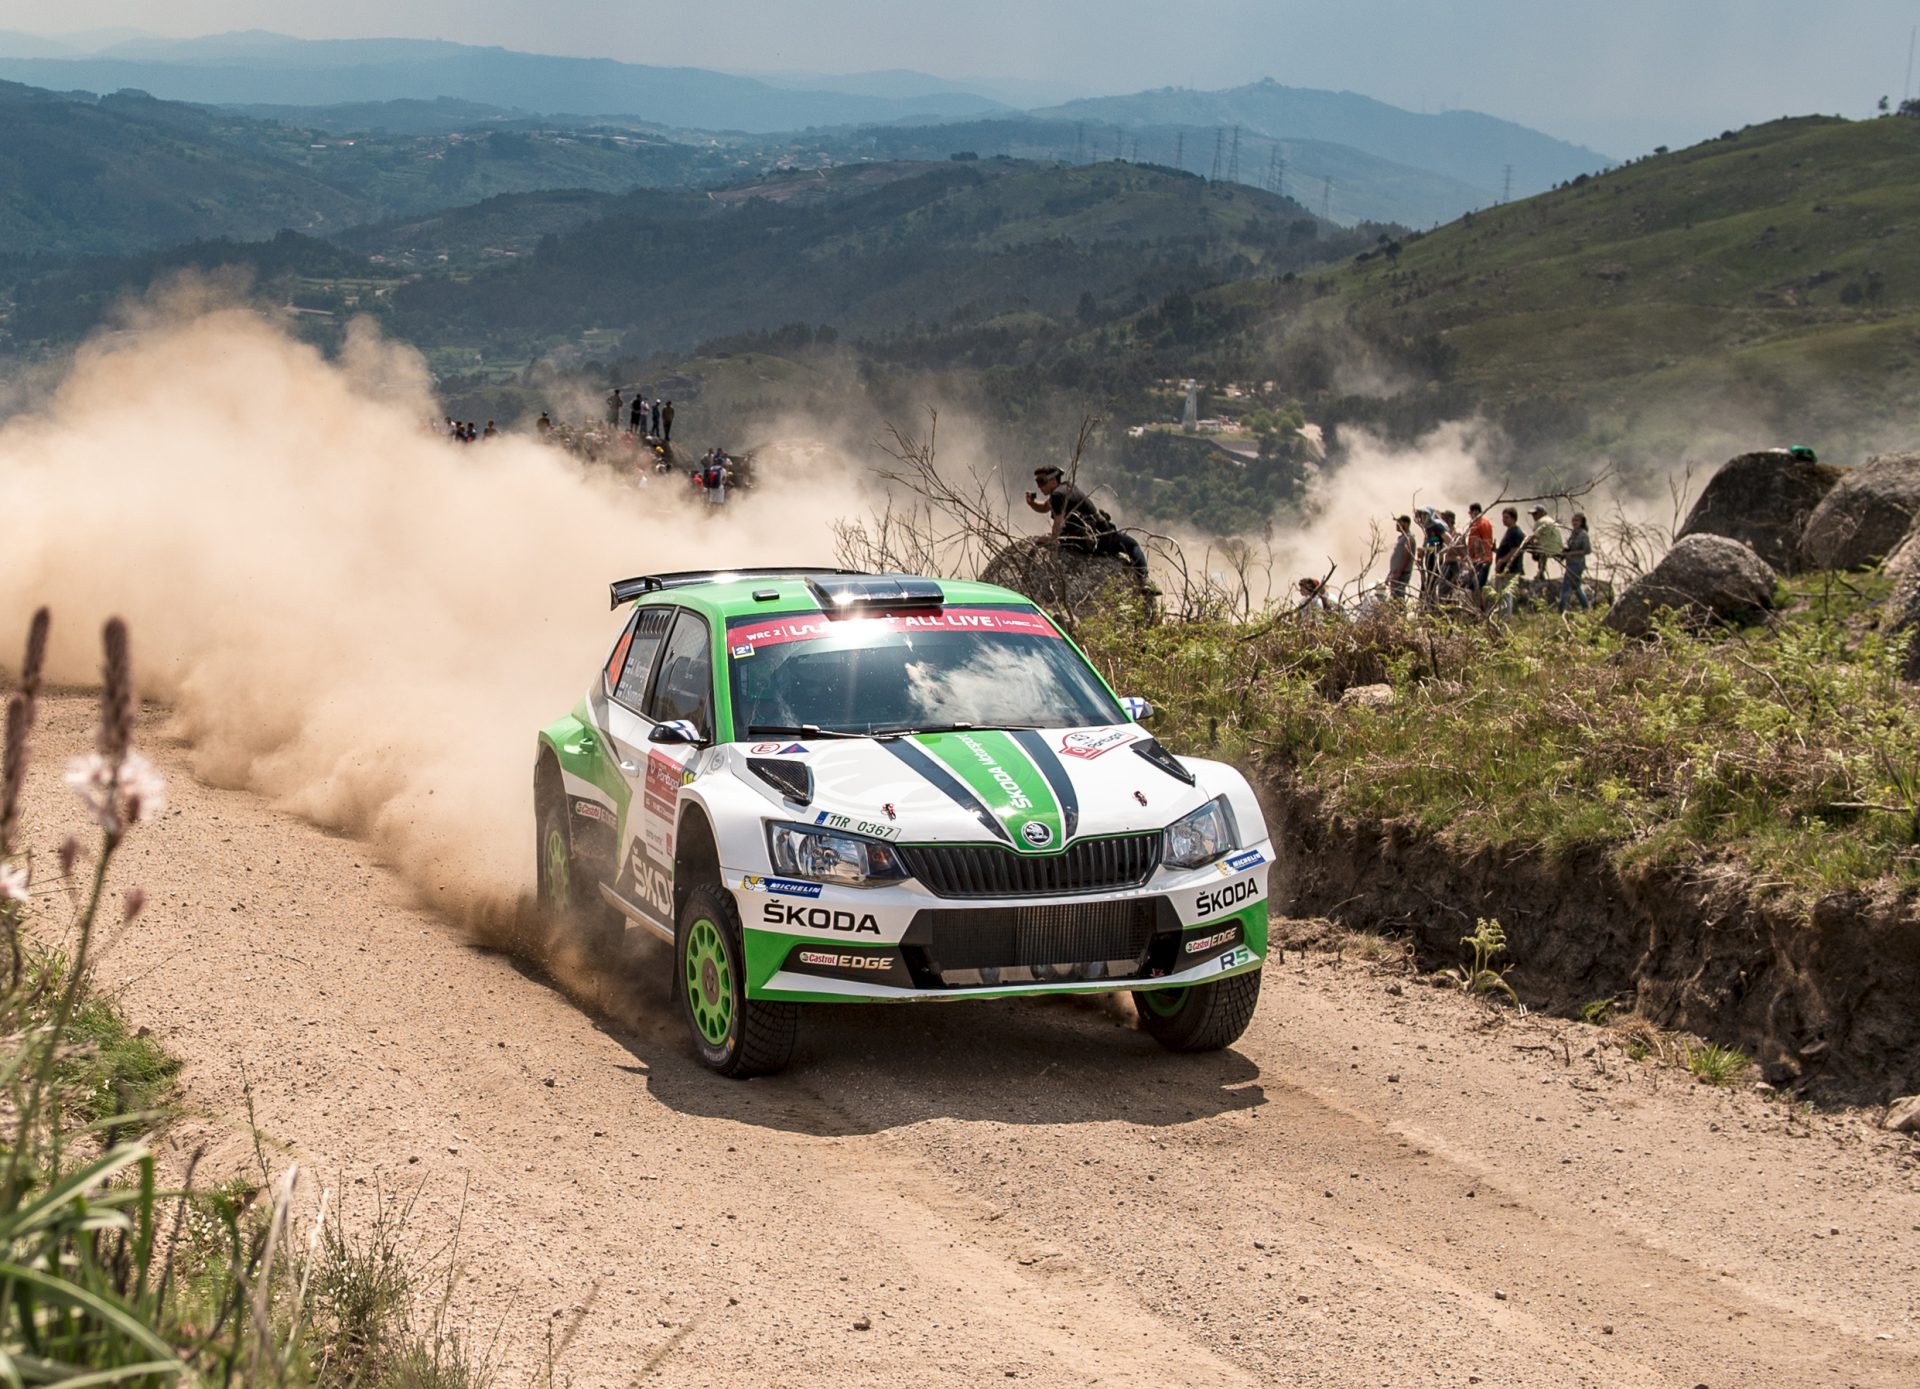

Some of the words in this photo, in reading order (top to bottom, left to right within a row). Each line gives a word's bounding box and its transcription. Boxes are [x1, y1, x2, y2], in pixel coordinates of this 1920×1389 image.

[905, 615, 944, 627] ALL
[946, 615, 994, 627] LIVE
[746, 631, 771, 641] WRC
[987, 766, 1033, 809] ŠKODA
[829, 814, 851, 829] 11R
[857, 821, 895, 838] 0367
[1232, 852, 1262, 868] MICHELIN
[769, 881, 821, 894] MICHELIN
[1196, 877, 1259, 917] ŠKODA
[762, 898, 881, 936] ŠKODA
[1192, 939, 1211, 951] Castrol
[1211, 926, 1238, 948] EDGE
[808, 953, 836, 965] Castrol
[838, 955, 895, 970] EDGE
[1220, 948, 1250, 971] R5
